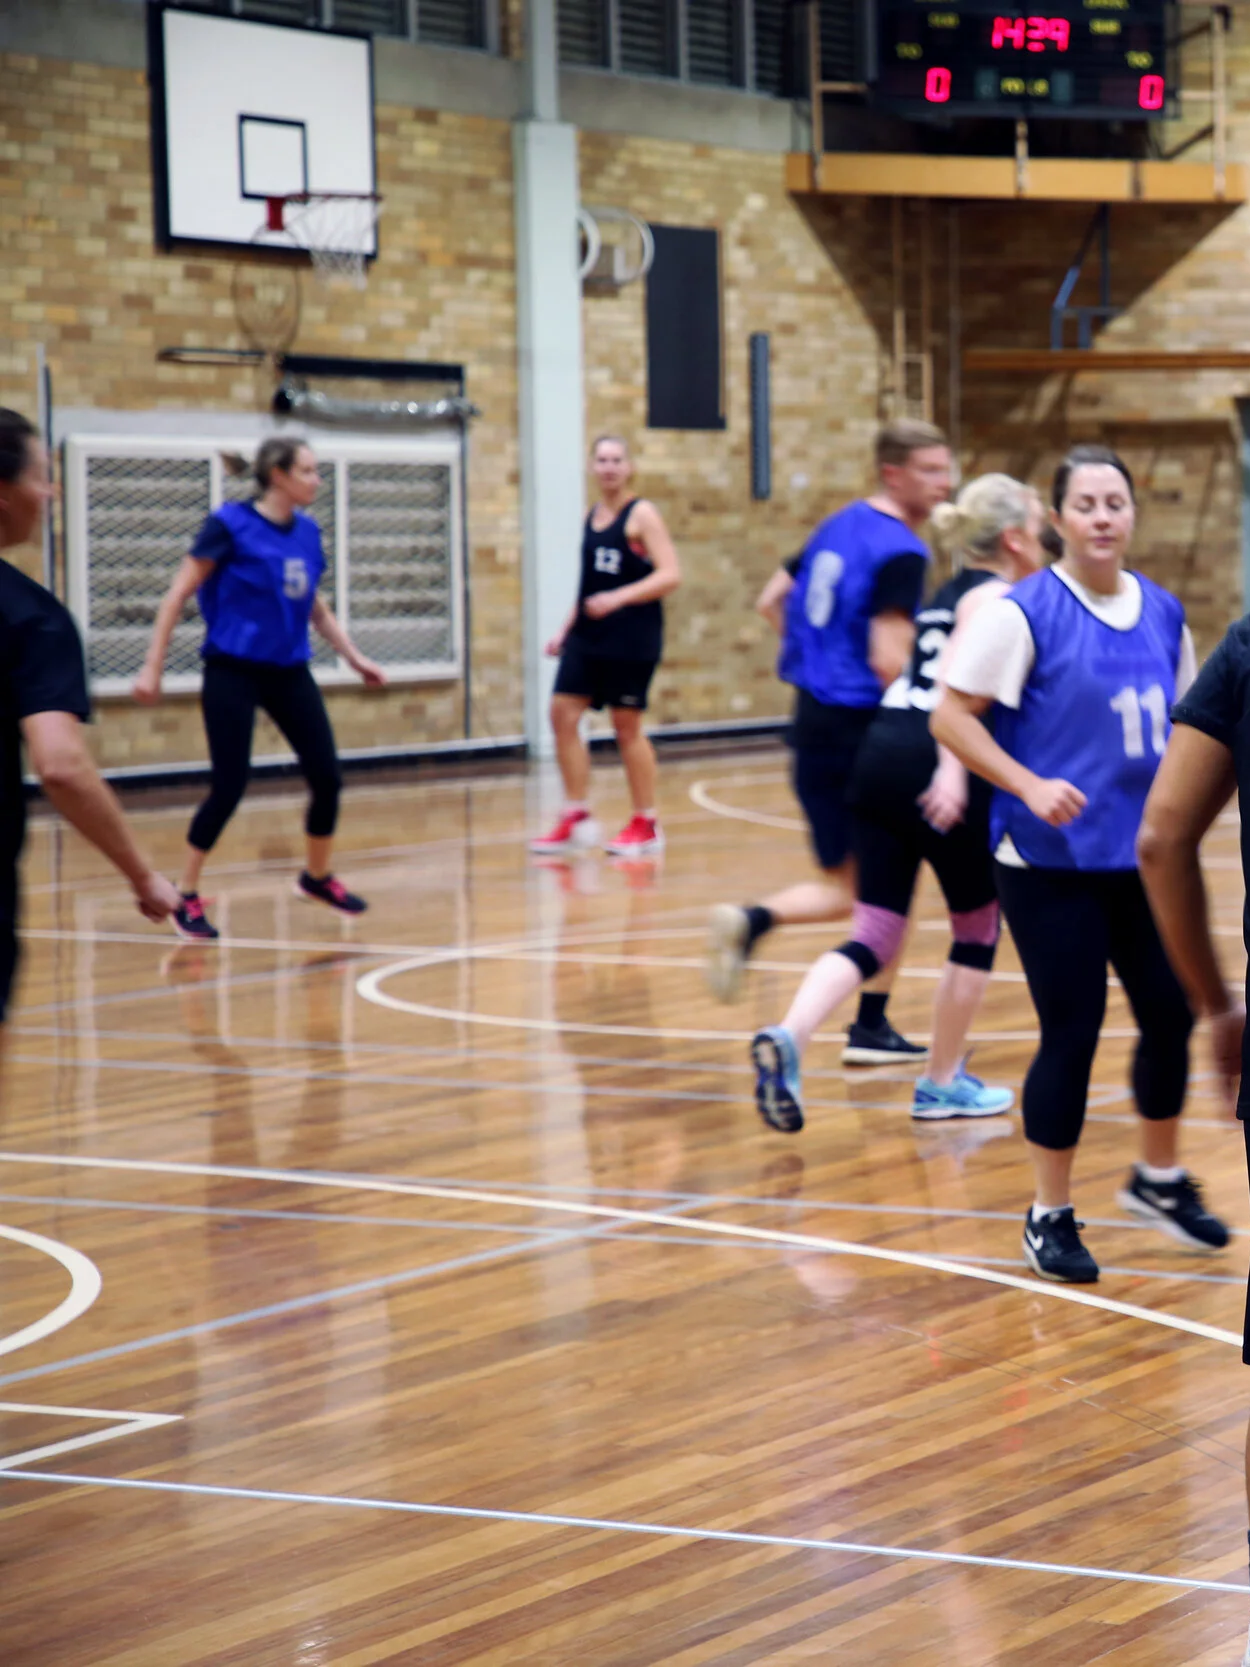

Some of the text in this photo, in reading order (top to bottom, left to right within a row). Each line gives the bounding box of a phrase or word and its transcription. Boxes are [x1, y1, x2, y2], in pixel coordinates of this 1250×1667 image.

[925, 67, 951, 102] 0
[1138, 74, 1165, 110] 0
[283, 557, 308, 600] 5
[1109, 684, 1166, 759] 11
